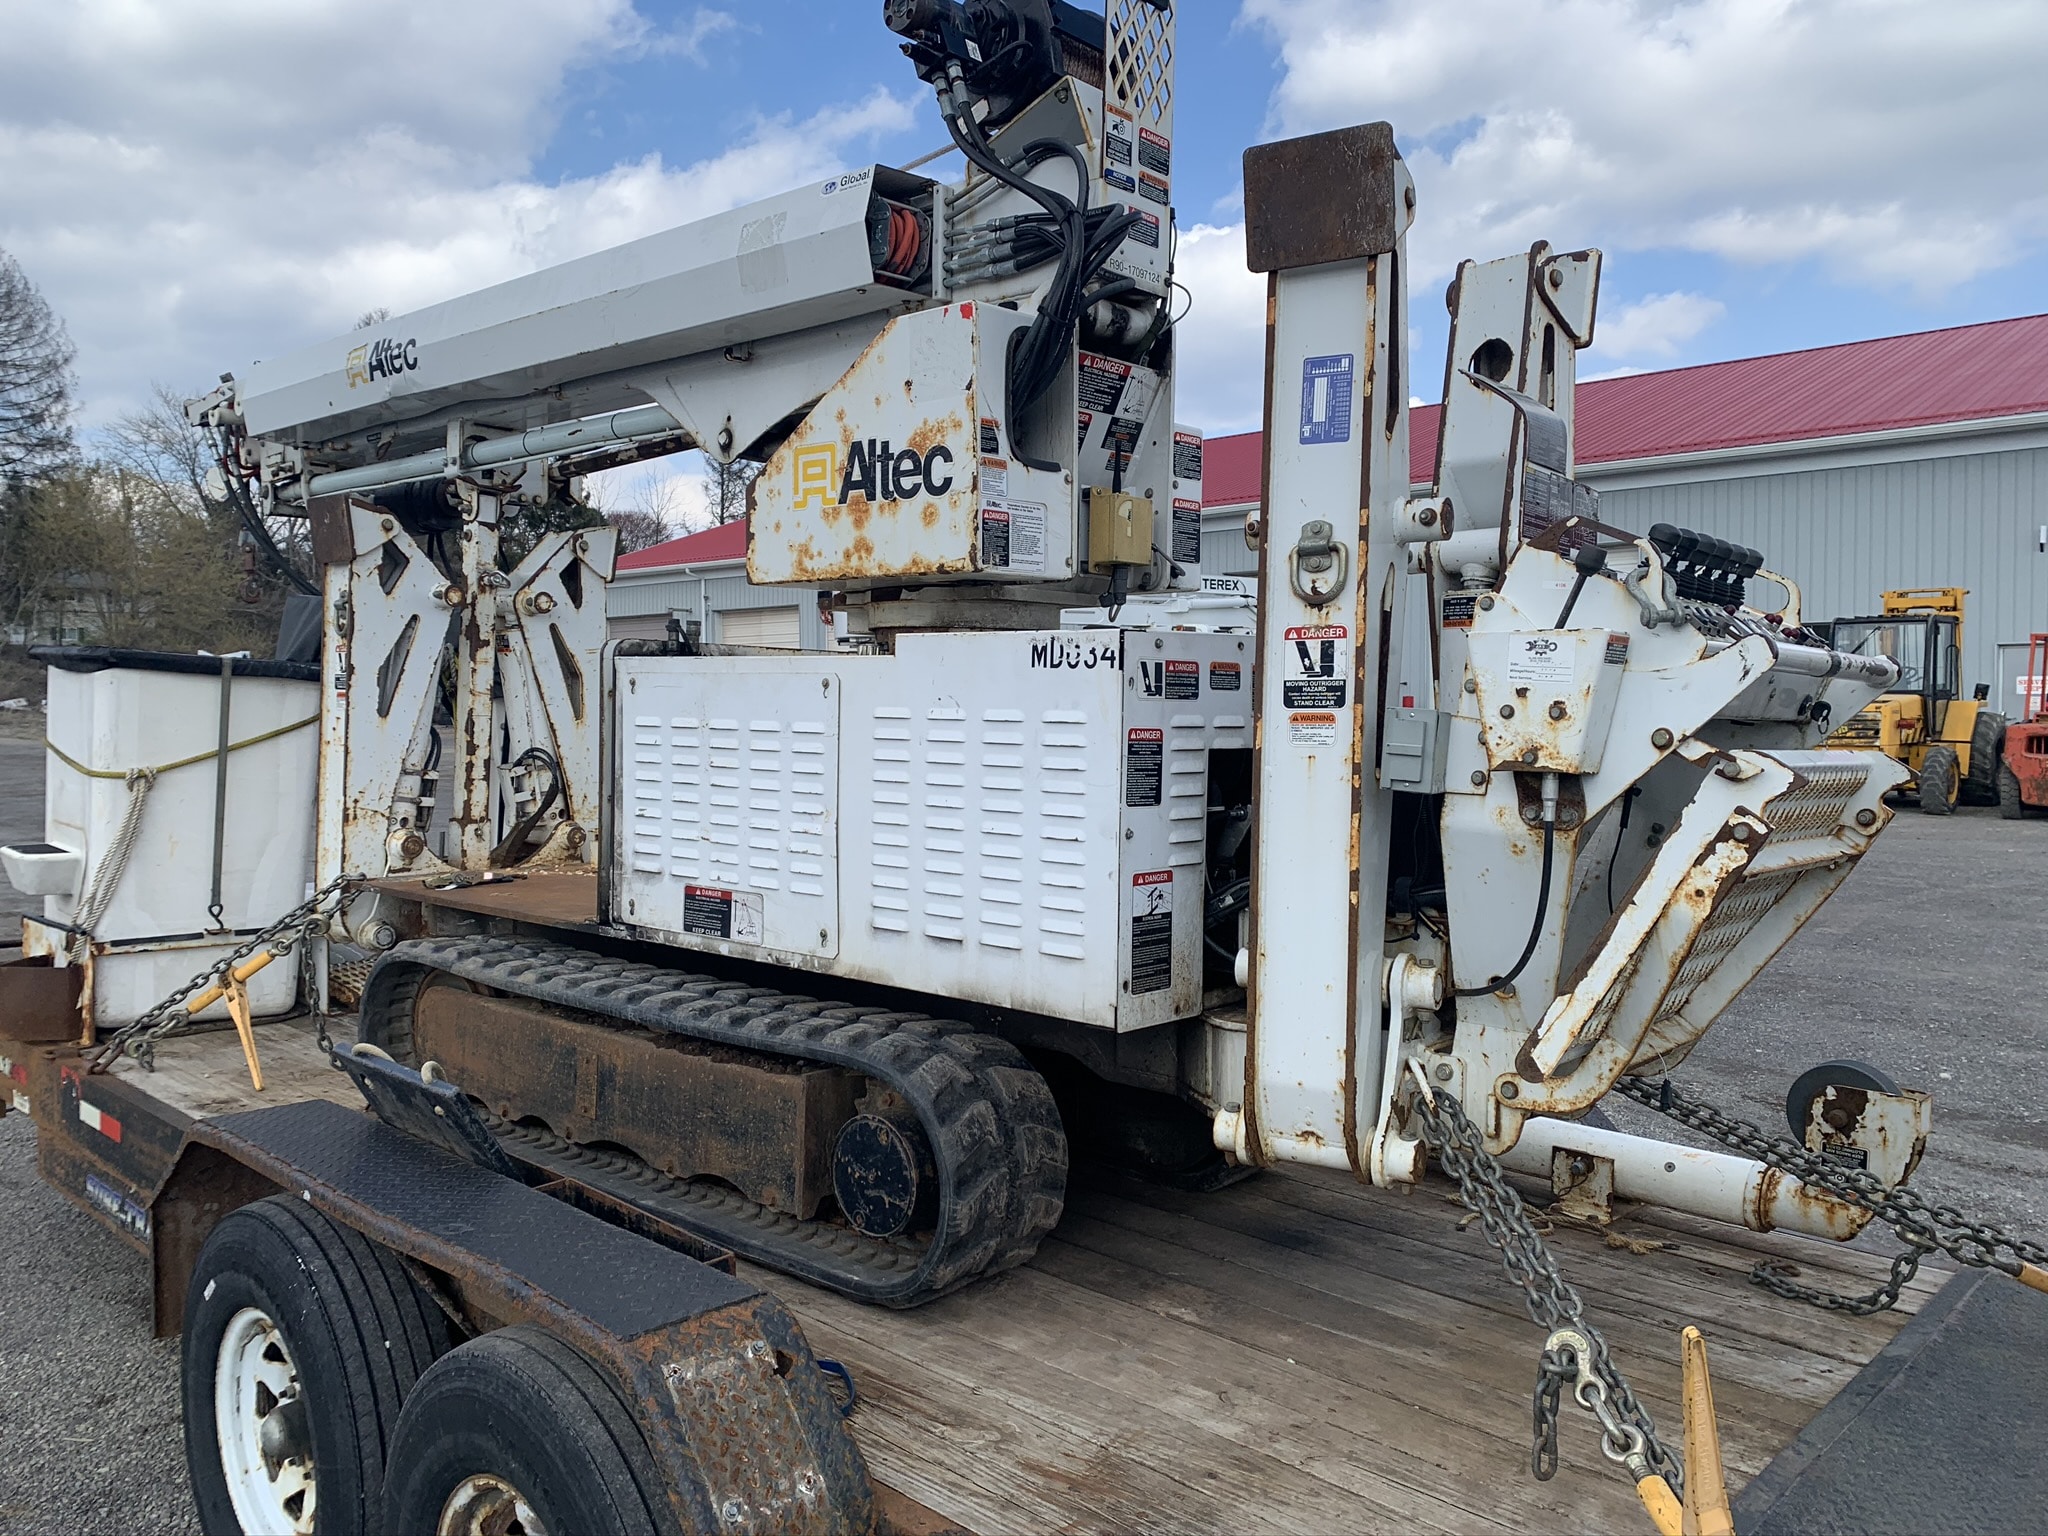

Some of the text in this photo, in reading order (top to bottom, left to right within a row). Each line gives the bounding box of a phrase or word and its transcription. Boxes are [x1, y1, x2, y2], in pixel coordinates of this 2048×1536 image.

[1146, 131, 1169, 149] DANGER
[1109, 258, 1160, 283] R90-17097124
[367, 337, 418, 382] Altec
[1093, 357, 1126, 375] DANGER
[1180, 434, 1200, 445] DANGER
[838, 437, 954, 505] Altec
[1180, 500, 1200, 509] DANGER
[988, 511, 1009, 520] DANGER
[1202, 578, 1240, 591] TEREX
[1301, 628, 1344, 638] DANGER
[1174, 663, 1197, 671] DANGER
[1136, 730, 1161, 739] DANGER
[1144, 873, 1168, 883] DANGER
[702, 889, 722, 898] DANGER
